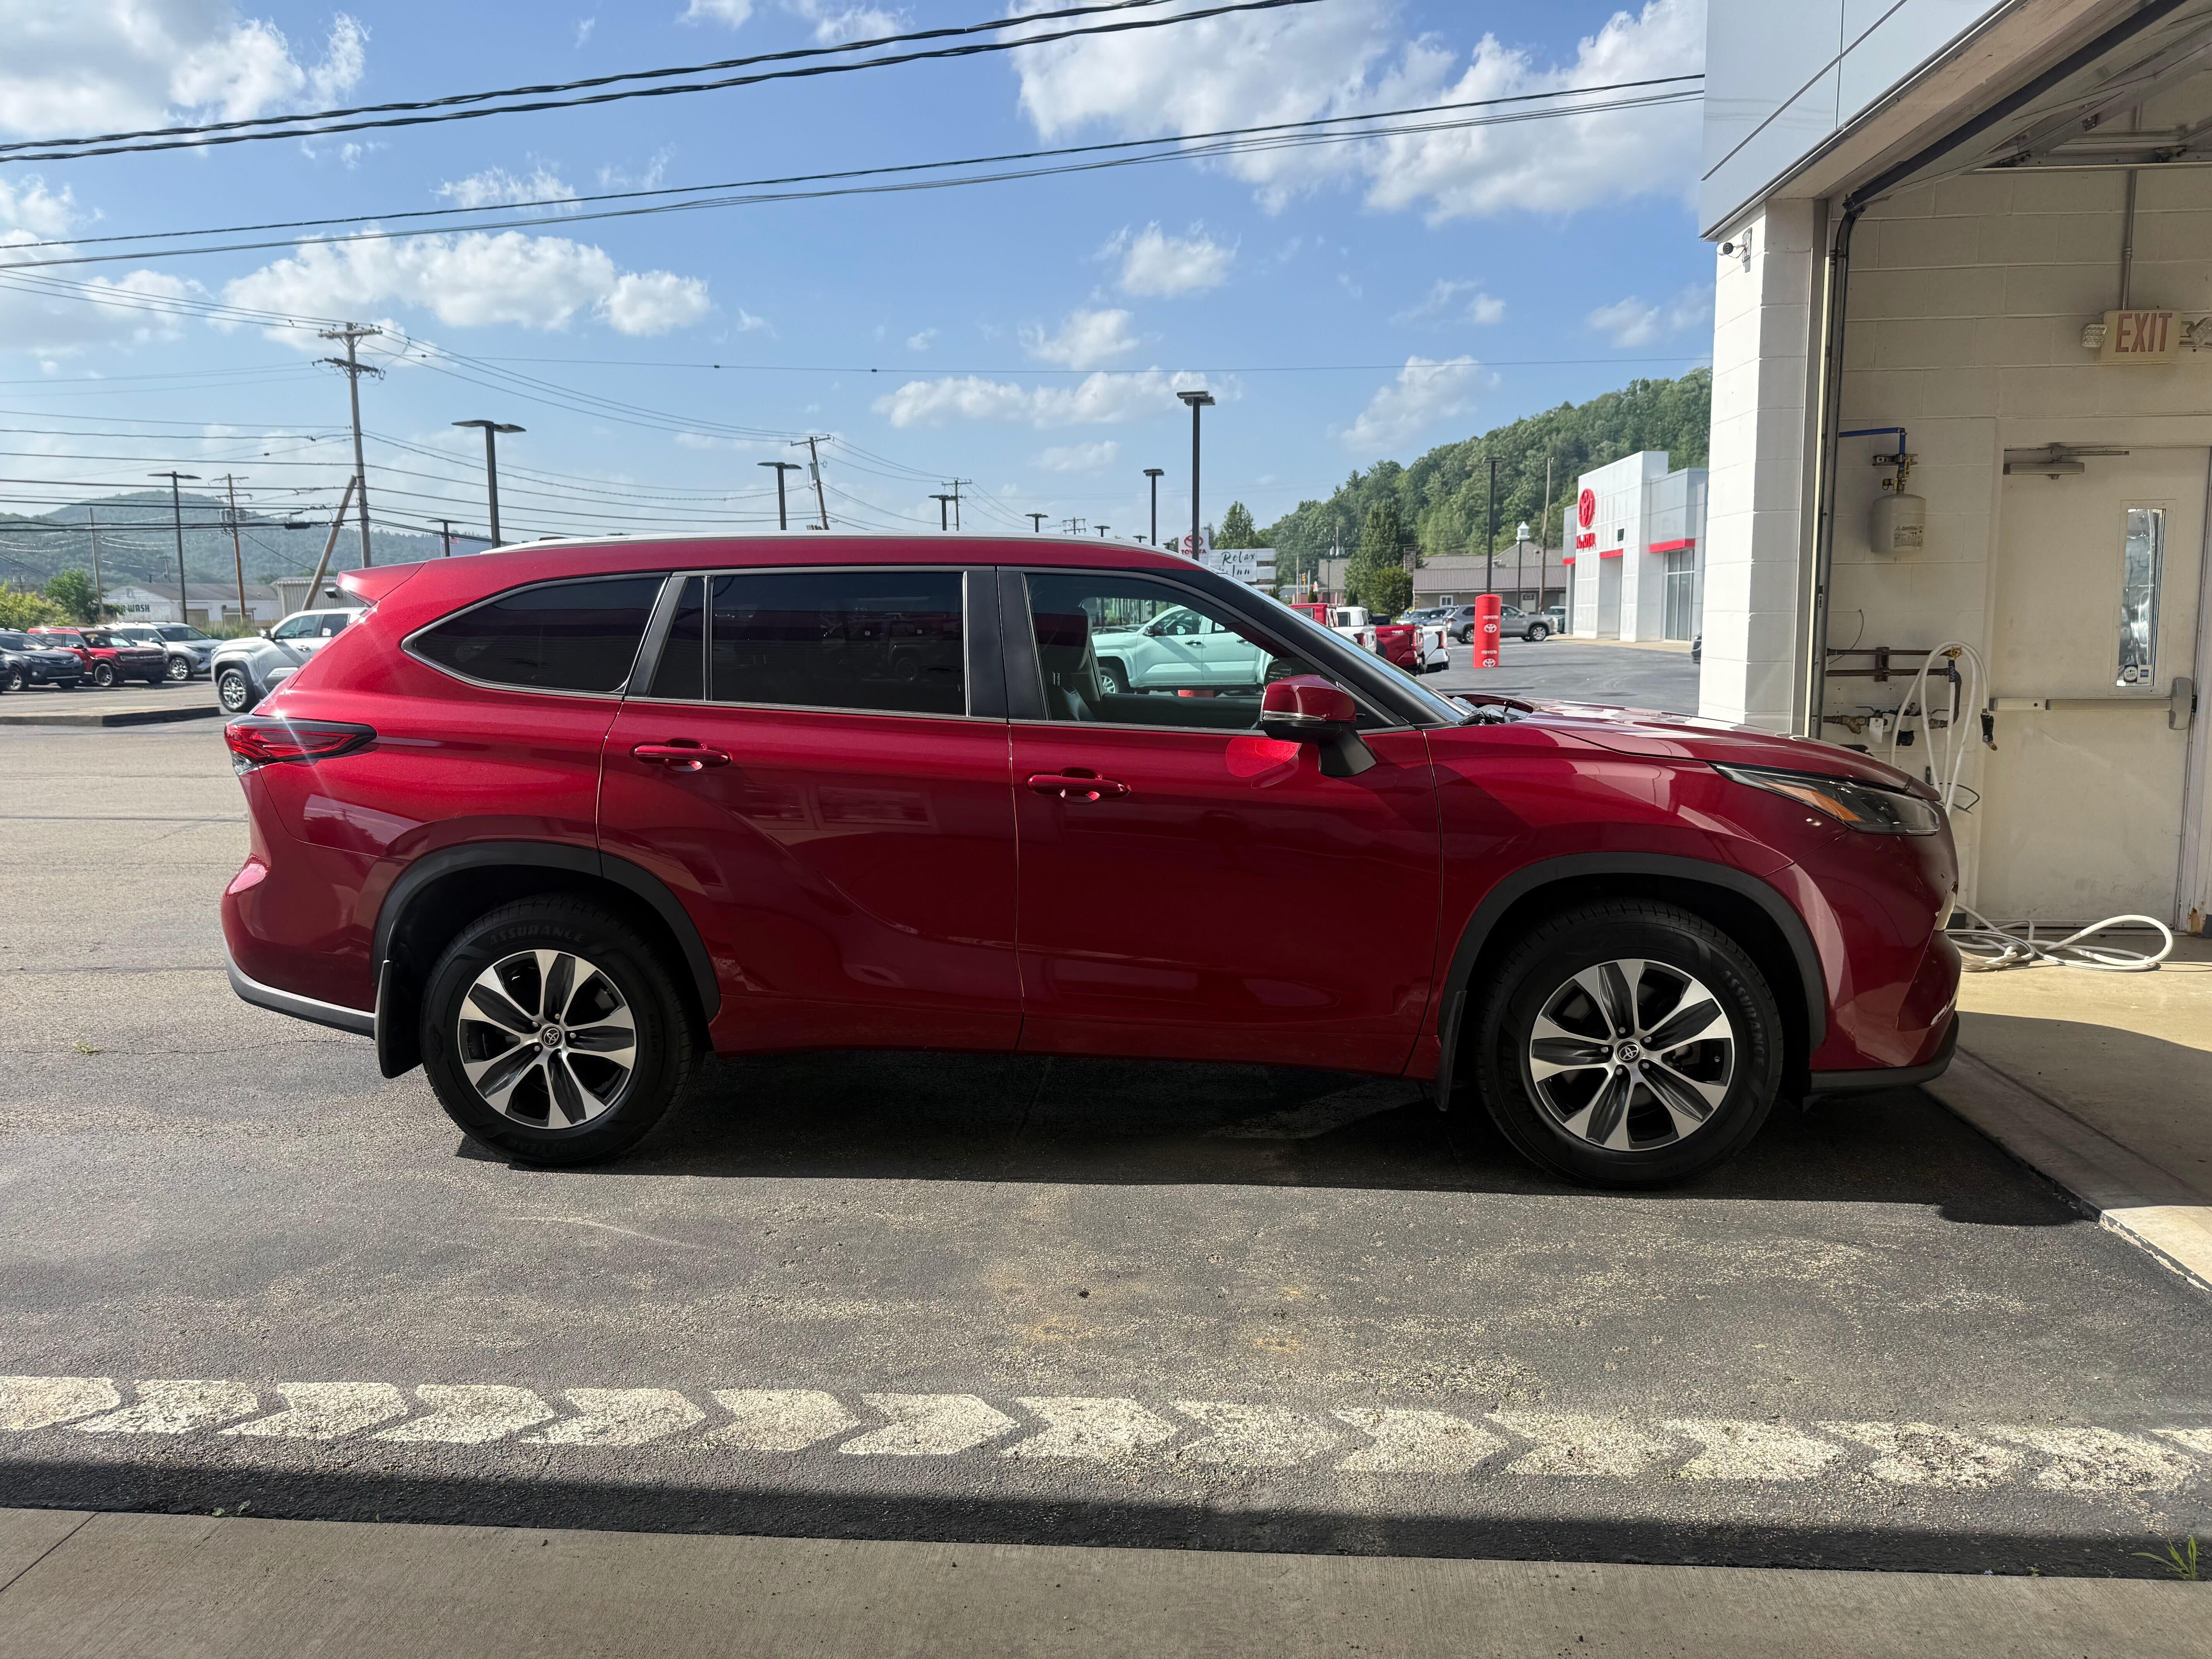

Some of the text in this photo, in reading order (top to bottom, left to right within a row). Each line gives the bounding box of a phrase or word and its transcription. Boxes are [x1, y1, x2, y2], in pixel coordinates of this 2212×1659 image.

[2115, 313, 2172, 352] EXIT
[1221, 551, 1255, 566] Relax
[1233, 565, 1251, 577] Inn
[489, 924, 585, 945] ASSURANCE
[1719, 970, 1765, 1066] ASSURANCE
[1501, 1045, 1548, 1139] OODYEAR
